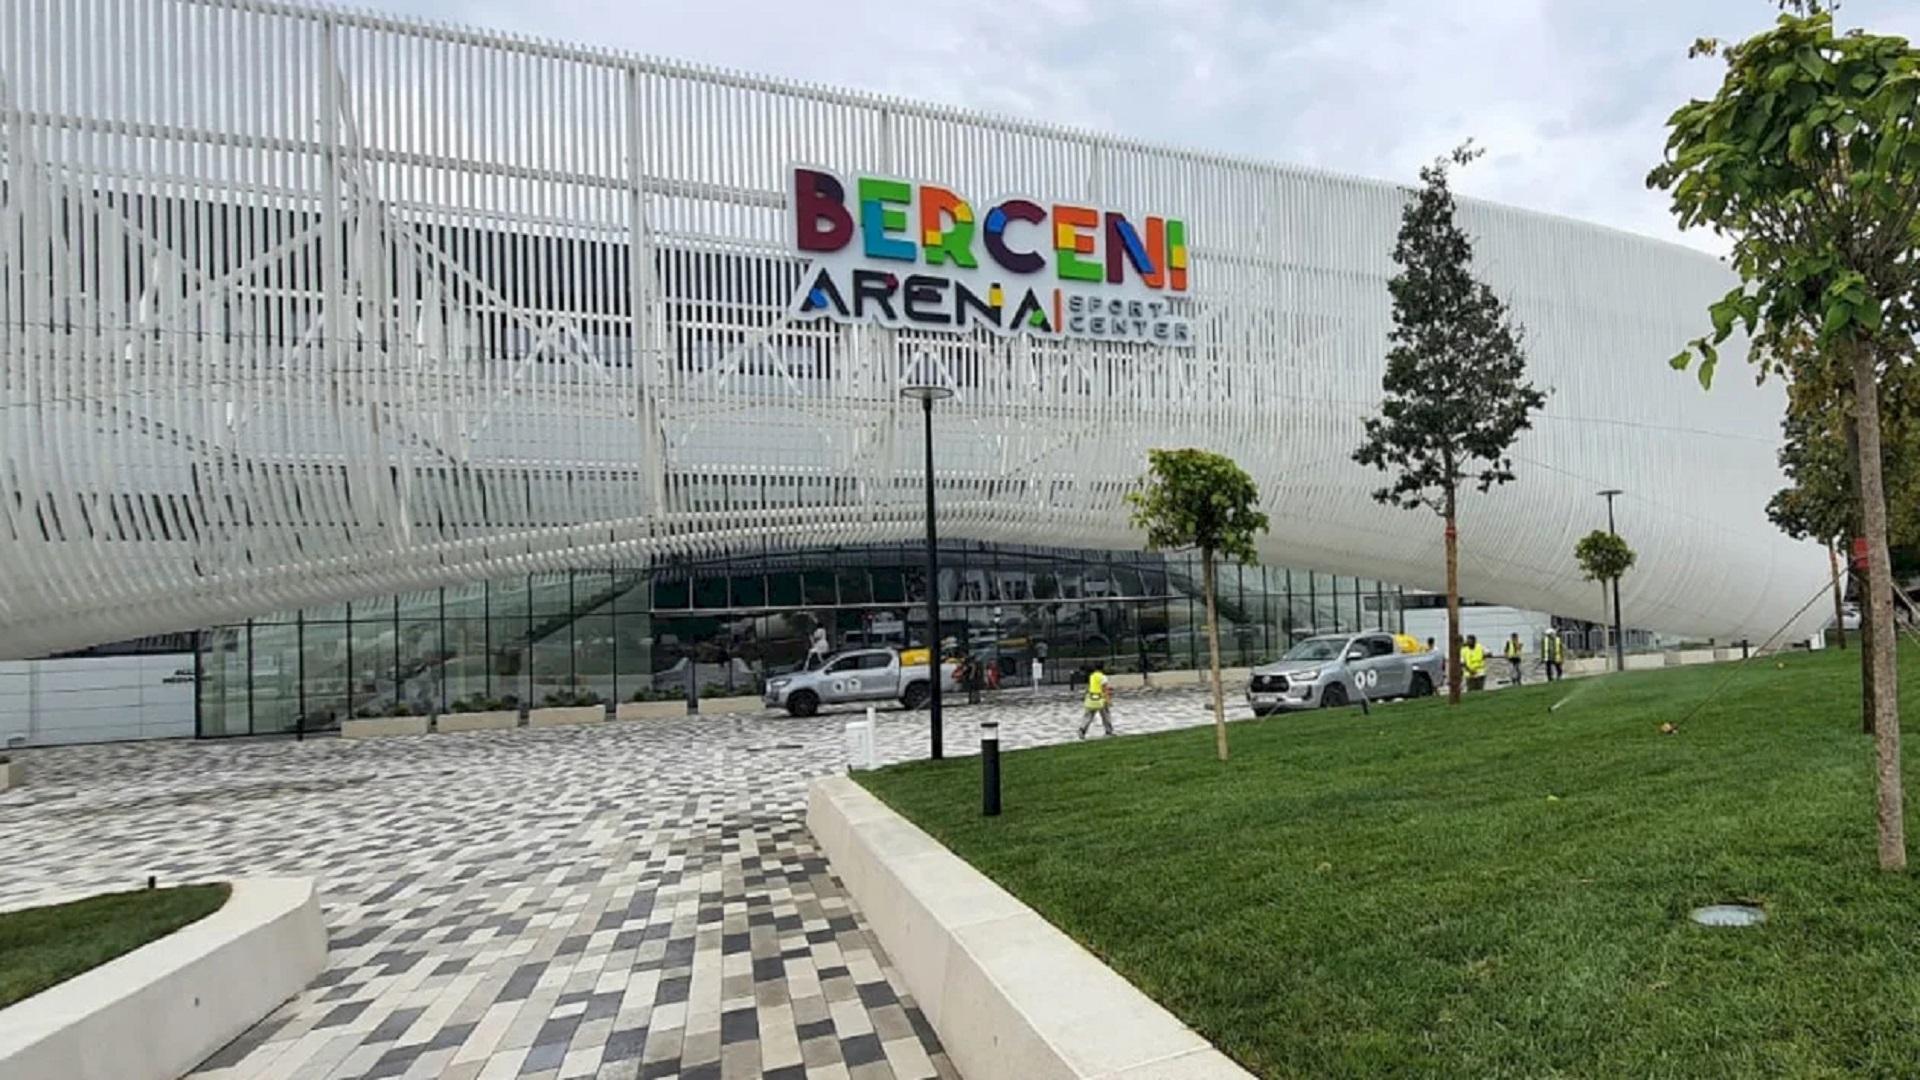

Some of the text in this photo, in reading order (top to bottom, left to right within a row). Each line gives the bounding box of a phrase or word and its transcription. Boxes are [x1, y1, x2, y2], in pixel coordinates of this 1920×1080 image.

[794, 168, 1189, 291] BERCENI
[800, 267, 1053, 333] ARENA
[1069, 296, 1163, 318] SPORT
[1069, 316, 1188, 340] CENTER
